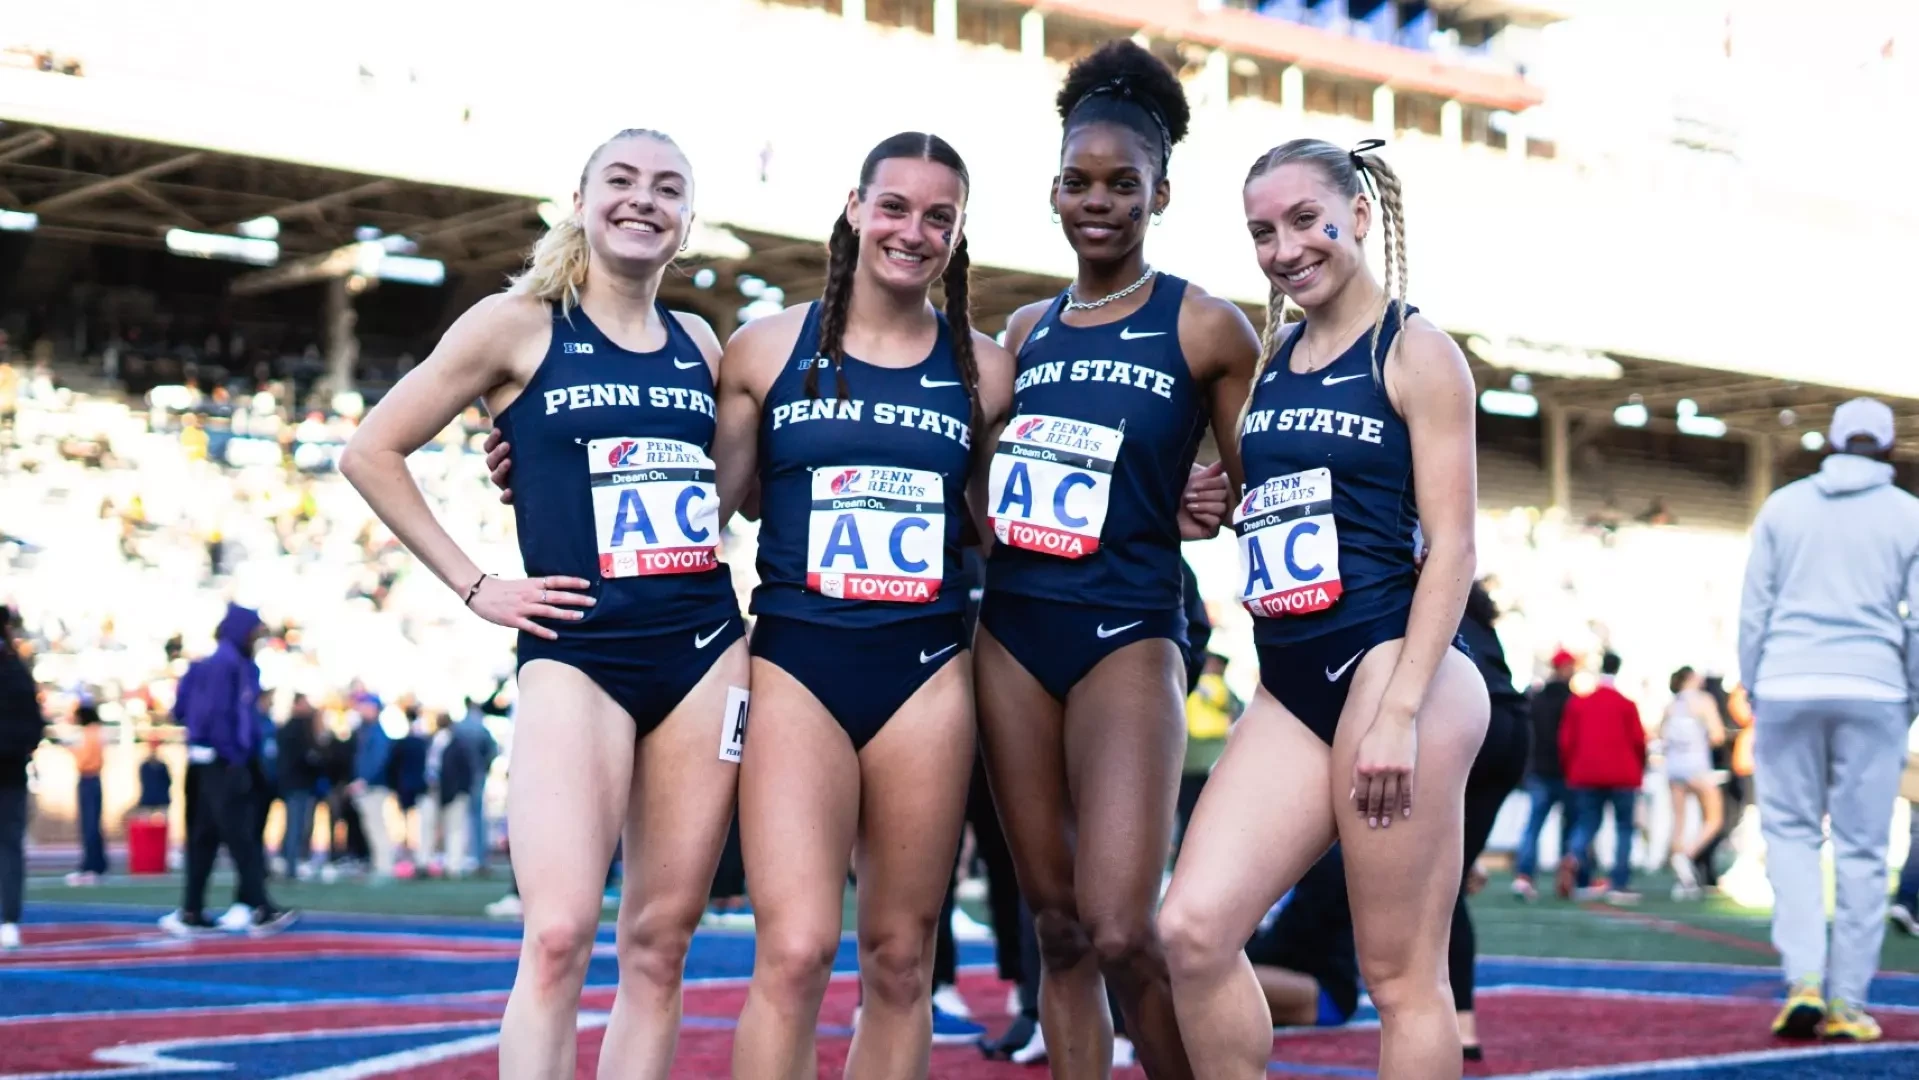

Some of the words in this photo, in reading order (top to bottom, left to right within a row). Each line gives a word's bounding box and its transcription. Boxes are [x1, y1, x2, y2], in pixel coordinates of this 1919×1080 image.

[1014, 361, 1066, 395] ENN
[1070, 359, 1175, 399] STATE
[544, 383, 640, 415] PENN
[648, 386, 718, 424] STAT
[772, 397, 864, 431] PENN
[873, 402, 973, 451] STATE
[1050, 420, 1093, 437] PENN
[1276, 407, 1385, 445] STATE
[646, 441, 683, 452] PENN
[1045, 432, 1103, 452] RELAYS
[646, 451, 700, 464] RELAYS
[1012, 444, 1041, 459] Dream
[1041, 450, 1058, 462] On.
[612, 473, 648, 484] Dream
[648, 470, 668, 481] On.
[870, 469, 913, 483] PENN
[1263, 476, 1301, 495] PENN
[867, 481, 926, 497] RELAYS
[996, 461, 1033, 519] A
[1053, 471, 1097, 528] C
[1263, 486, 1316, 509] RELAYS
[832, 499, 867, 509] Dream
[867, 498, 886, 510] On.
[610, 489, 660, 548] A
[675, 485, 710, 543] C
[1243, 519, 1266, 532] Dream
[1265, 514, 1282, 526] On.
[819, 513, 869, 570] A
[889, 516, 931, 574] C
[1011, 525, 1083, 555] TOYOTA
[1243, 535, 1274, 597] A
[1284, 521, 1324, 582] C
[848, 577, 930, 598] TOYOTA
[1263, 587, 1330, 614] TOYOTA
